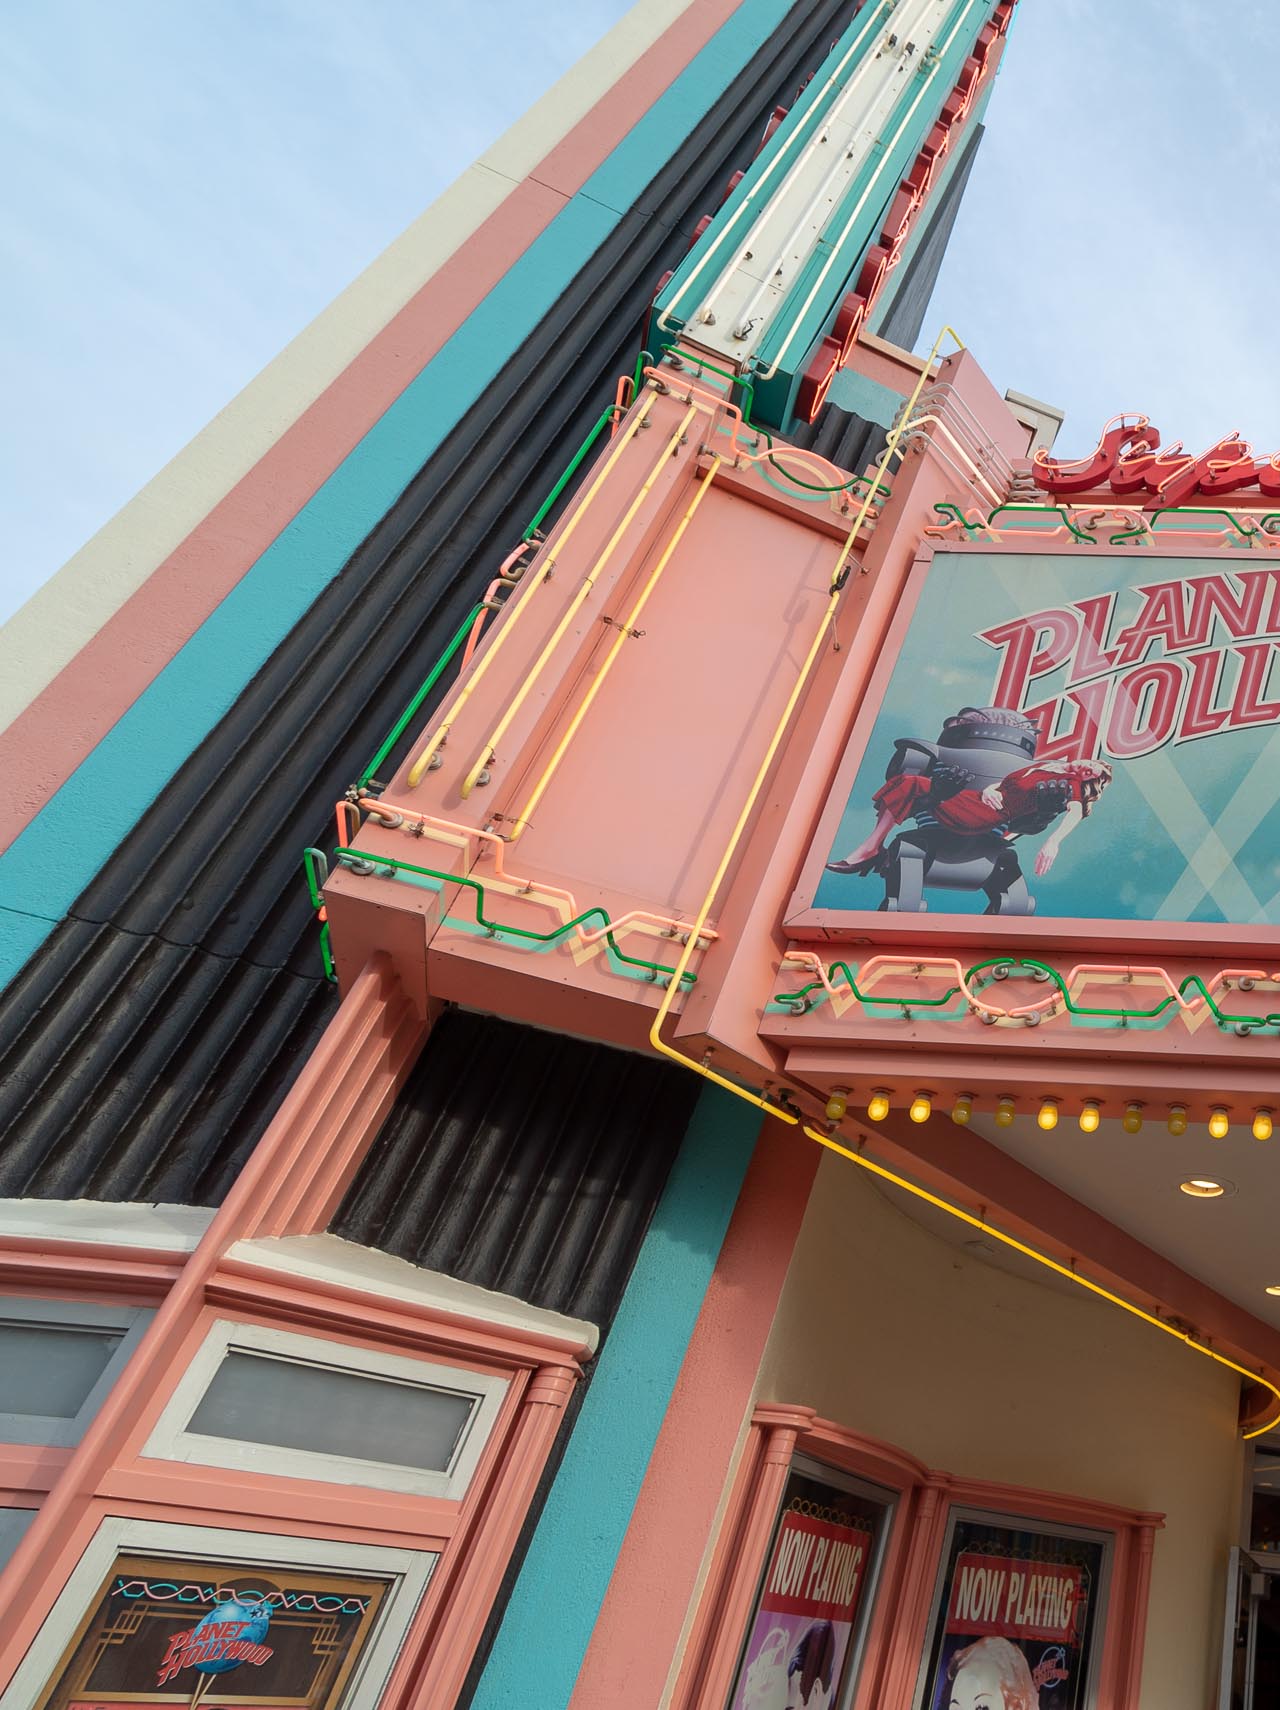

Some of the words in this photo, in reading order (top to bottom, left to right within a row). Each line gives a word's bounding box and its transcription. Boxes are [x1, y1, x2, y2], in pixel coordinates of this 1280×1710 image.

[769, 1527, 816, 1598] NOW
[804, 1536, 863, 1607] PLAYING
[954, 1566, 1006, 1622] NOW
[1004, 1571, 1074, 1630] PLAYING
[156, 1639, 274, 1688] HOLLYWOOD
[160, 1620, 253, 1665] PLANET
